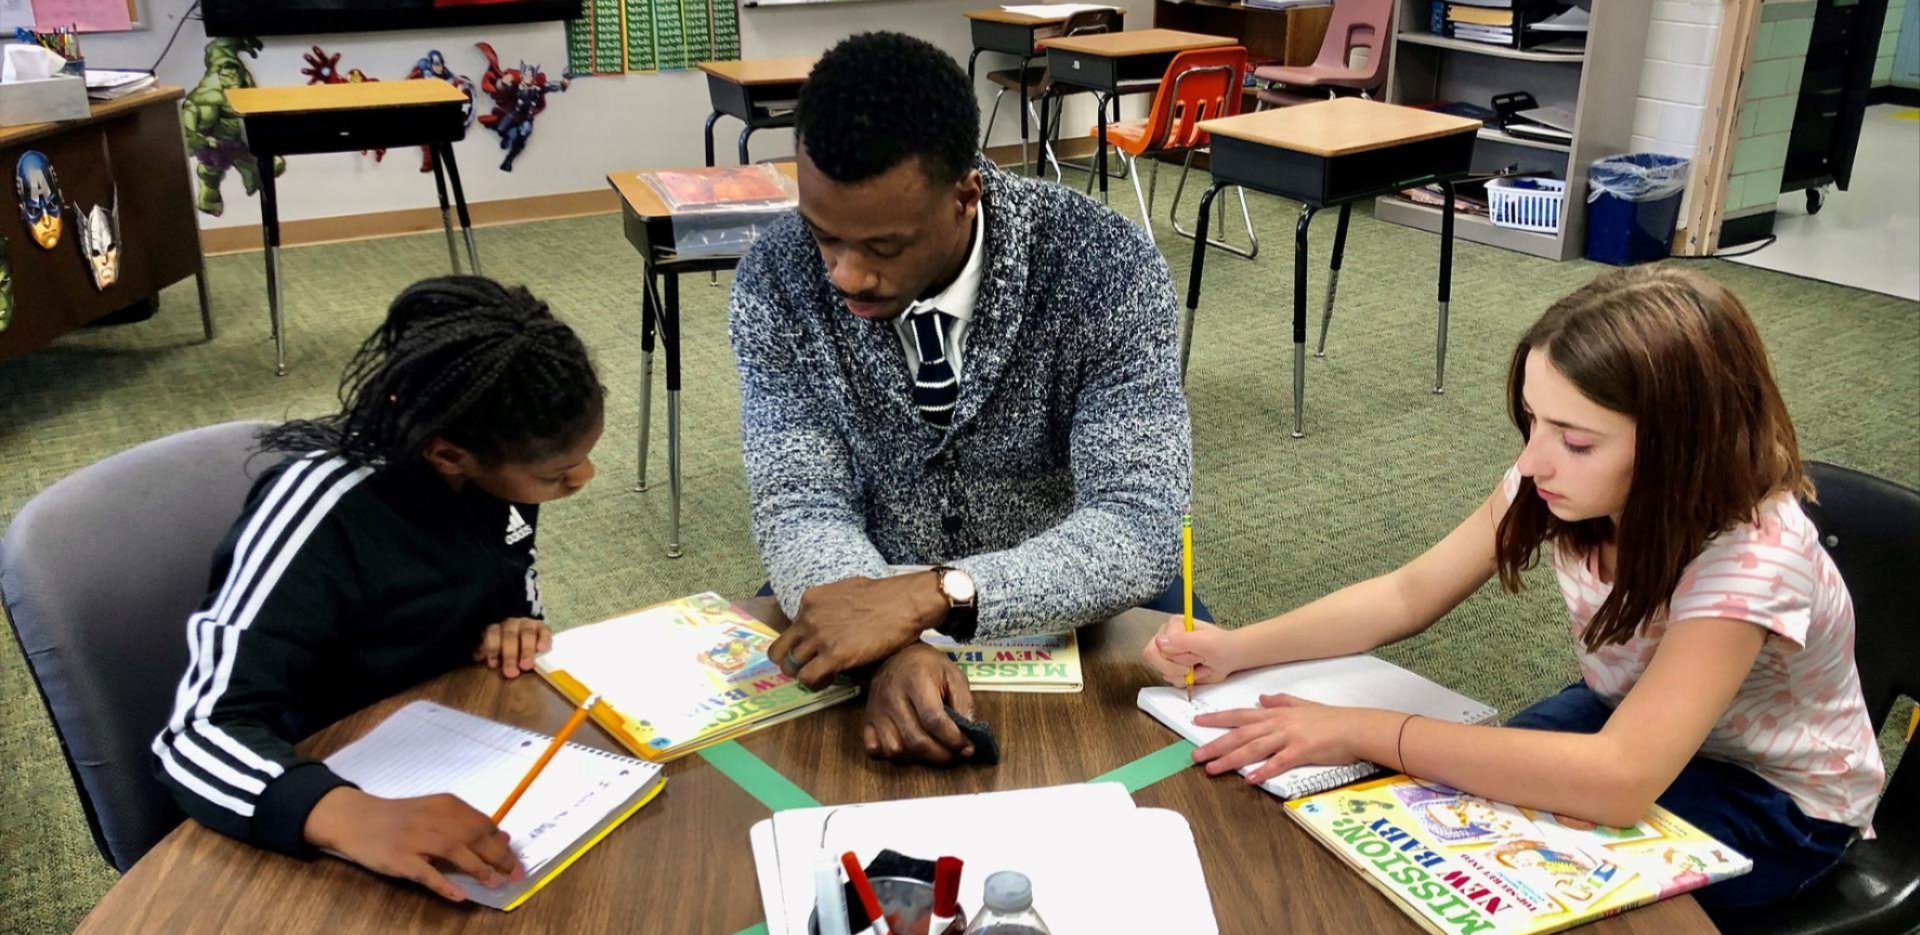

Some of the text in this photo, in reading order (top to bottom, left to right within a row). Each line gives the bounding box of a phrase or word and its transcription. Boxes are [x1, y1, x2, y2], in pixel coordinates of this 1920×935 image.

[27, 168, 52, 203] A
[946, 650, 1052, 662] NEW BA
[957, 662, 1069, 678] MISSI
[752, 671, 797, 694] EW
[1362, 817, 1446, 868] BABY
[1332, 818, 1496, 935] MISSION:
[1436, 870, 1513, 915] NEW
